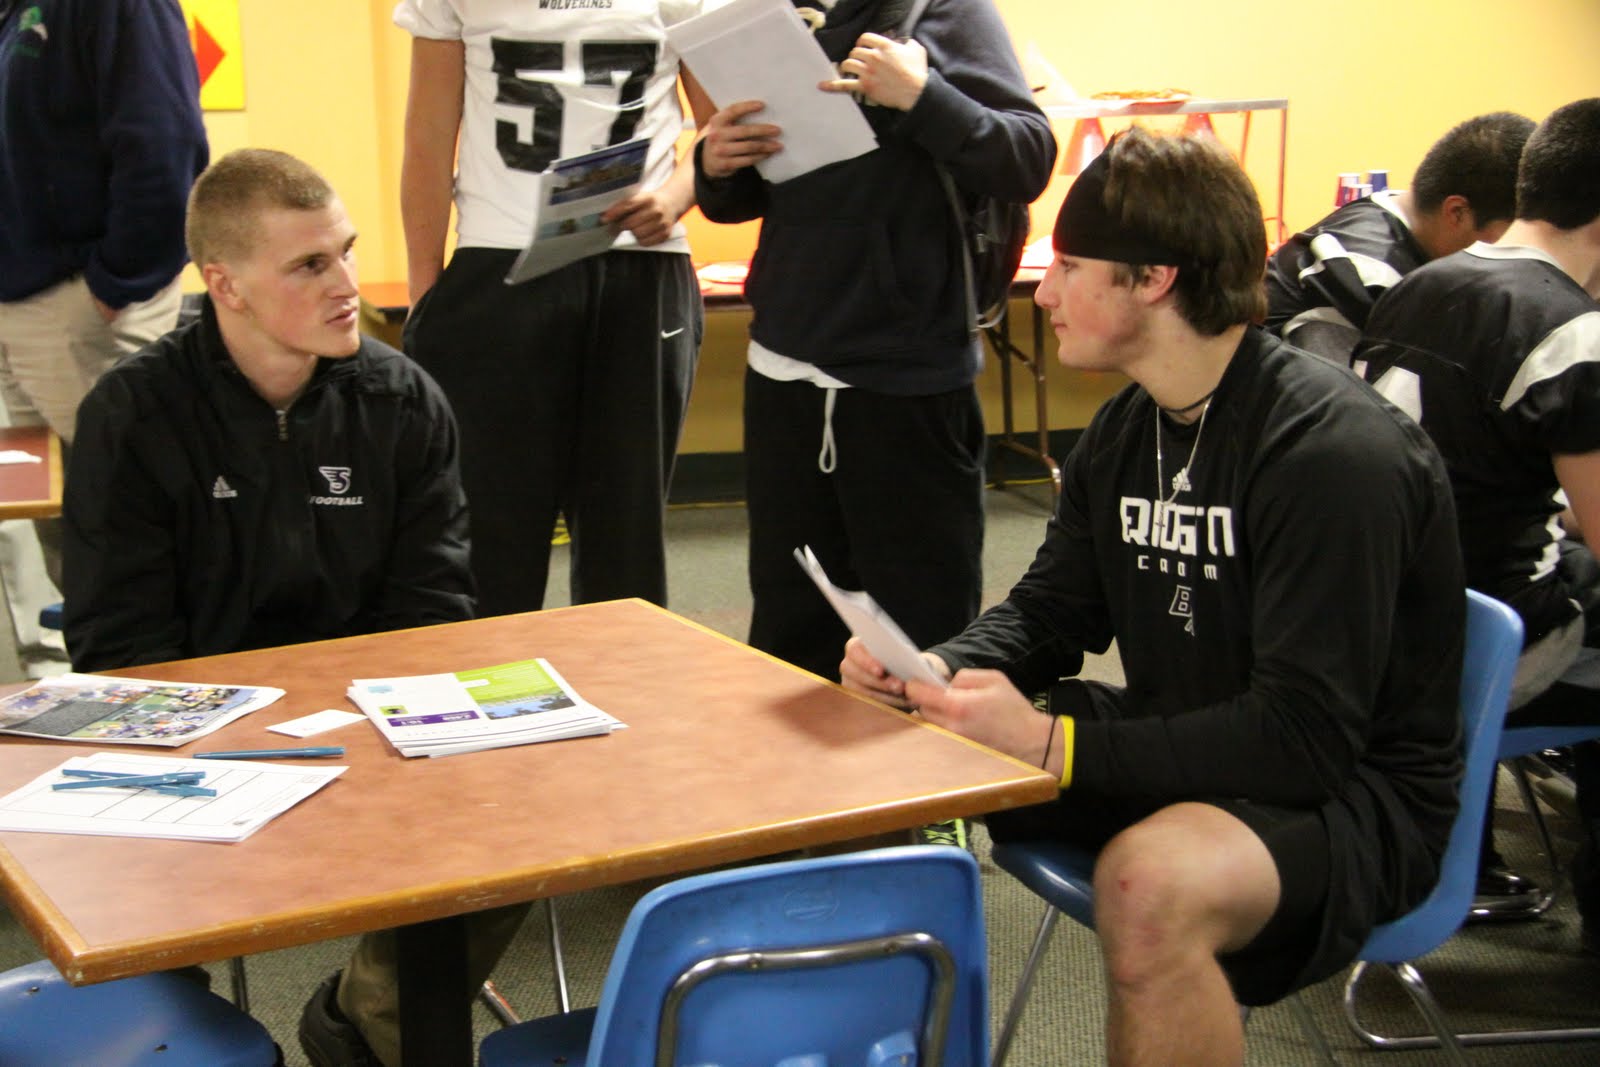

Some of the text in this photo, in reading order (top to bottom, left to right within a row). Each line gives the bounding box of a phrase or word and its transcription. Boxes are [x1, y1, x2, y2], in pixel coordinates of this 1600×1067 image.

[539, 0, 613, 10] WOLVERINES
[490, 36, 660, 173] 57
[309, 495, 364, 506] FOOTBALL
